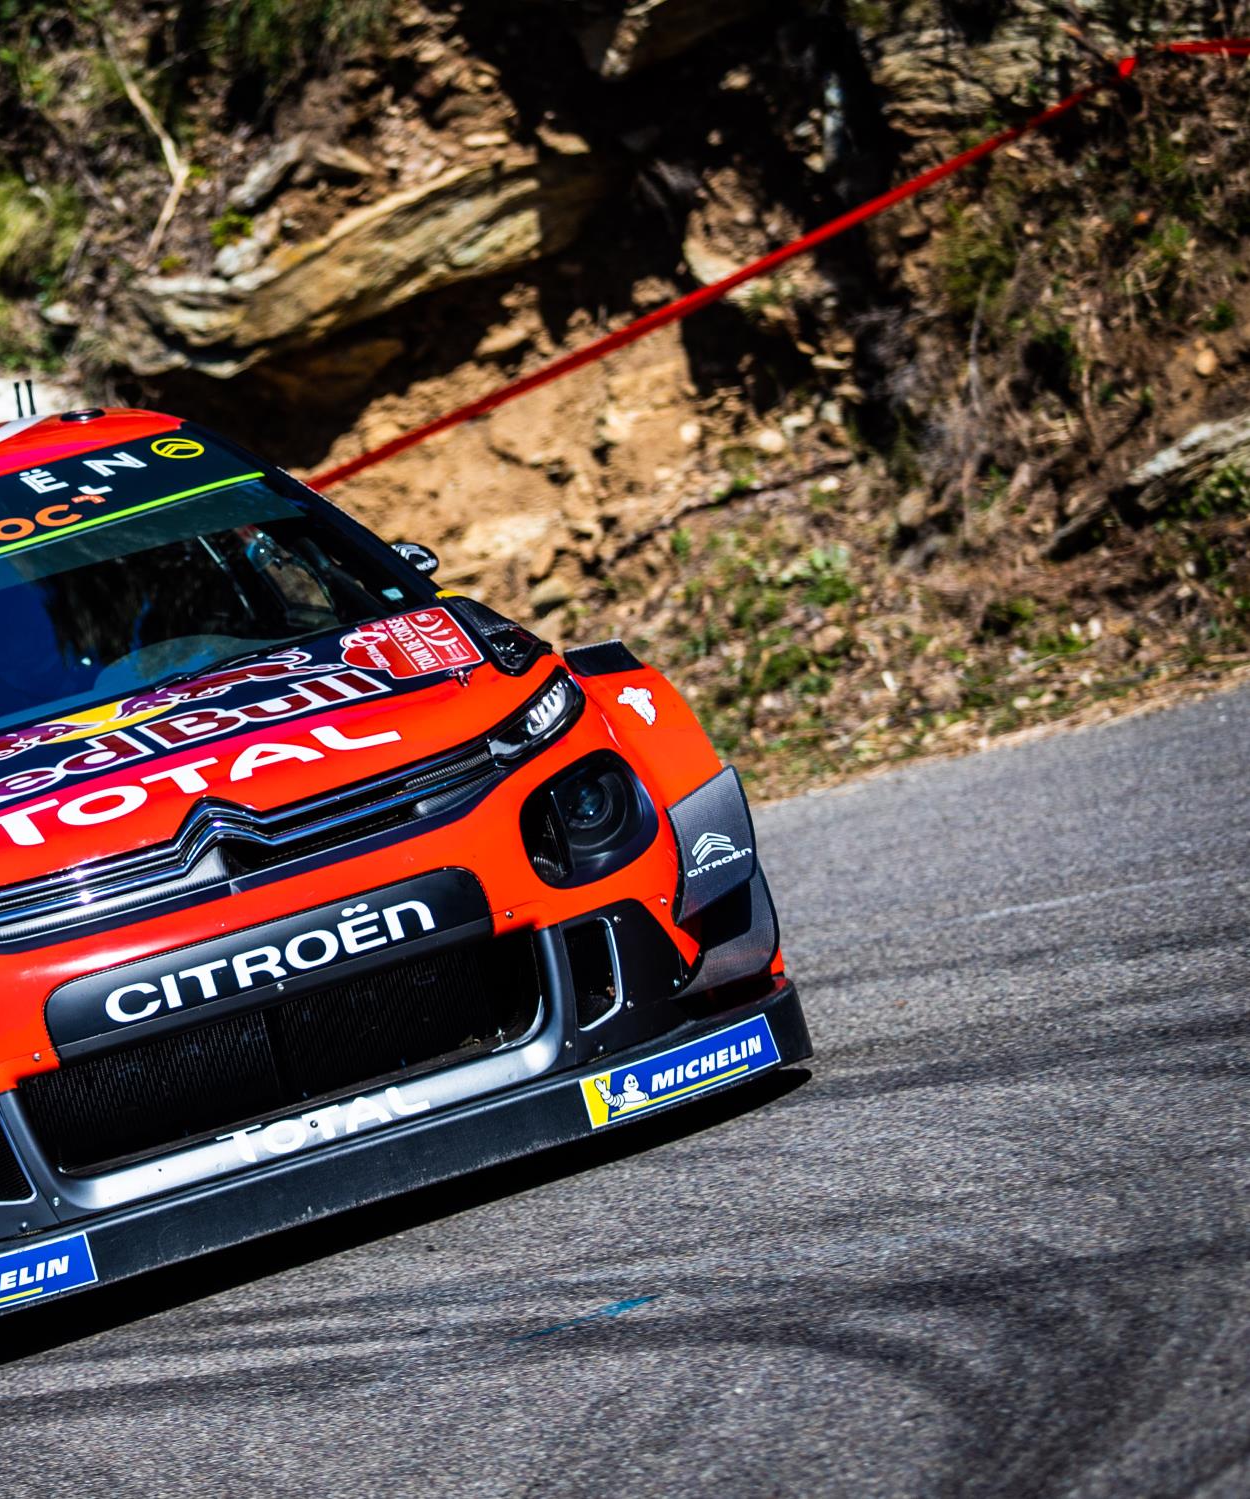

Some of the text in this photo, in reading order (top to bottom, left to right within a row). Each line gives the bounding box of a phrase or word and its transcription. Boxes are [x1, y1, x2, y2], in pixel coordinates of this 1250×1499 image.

[386, 617, 416, 641] CORSE
[410, 651, 439, 671] TOUR
[146, 670, 392, 750] Bull
[651, 1035, 762, 1093] MICHELIN
[215, 1086, 431, 1163] TOTAL
